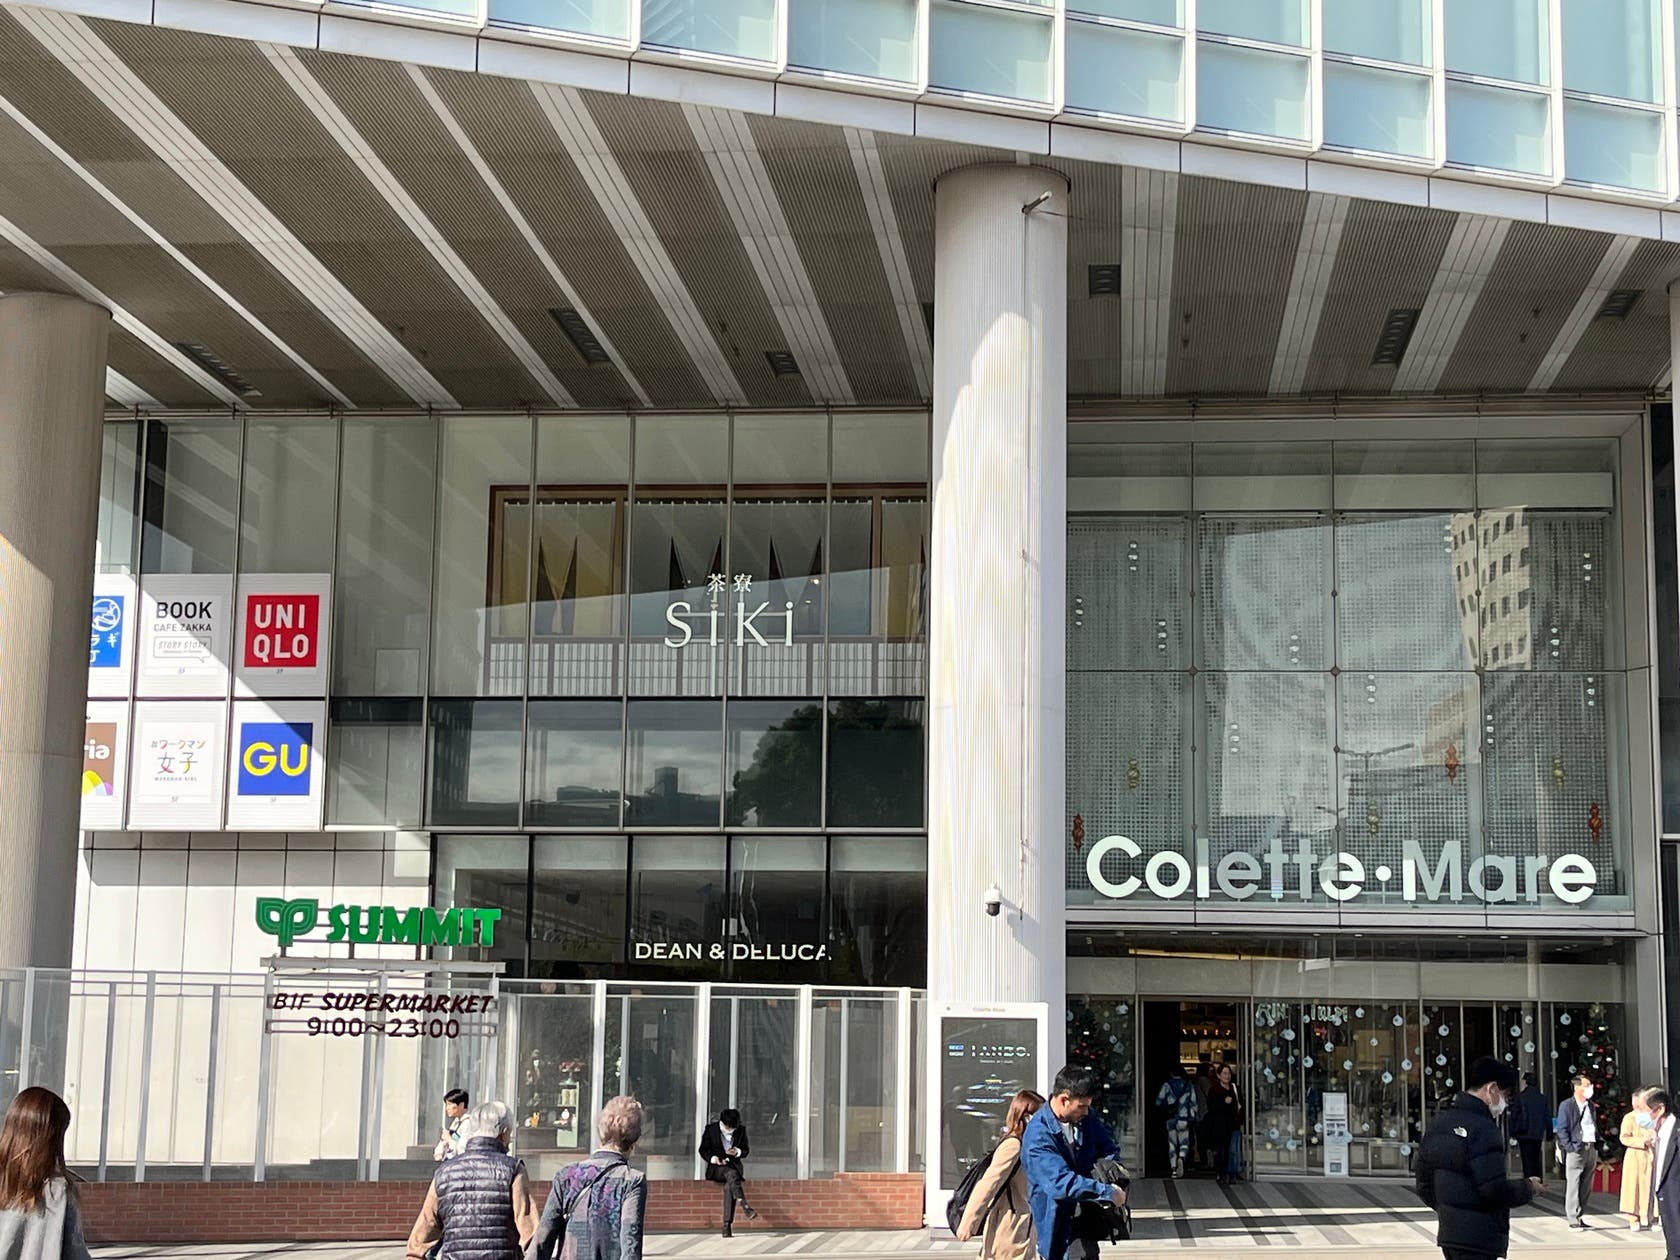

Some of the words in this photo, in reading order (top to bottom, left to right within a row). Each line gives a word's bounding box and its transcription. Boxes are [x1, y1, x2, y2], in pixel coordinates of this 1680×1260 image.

[707, 573, 752, 593] 茶寮
[156, 602, 213, 619] BOOK
[254, 604, 306, 629] UNI
[153, 624, 177, 632] CAFE
[180, 623, 212, 632] ZAKKA
[253, 634, 310, 663] QLO
[157, 752, 198, 774] 女子
[243, 741, 309, 777] GU
[326, 904, 502, 948] SUMMIT
[635, 943, 702, 960] DEAN
[709, 943, 725, 960] &
[733, 943, 832, 961] DELUCA
[273, 993, 314, 1011] B1F
[321, 993, 495, 1014] SUPERMARKET
